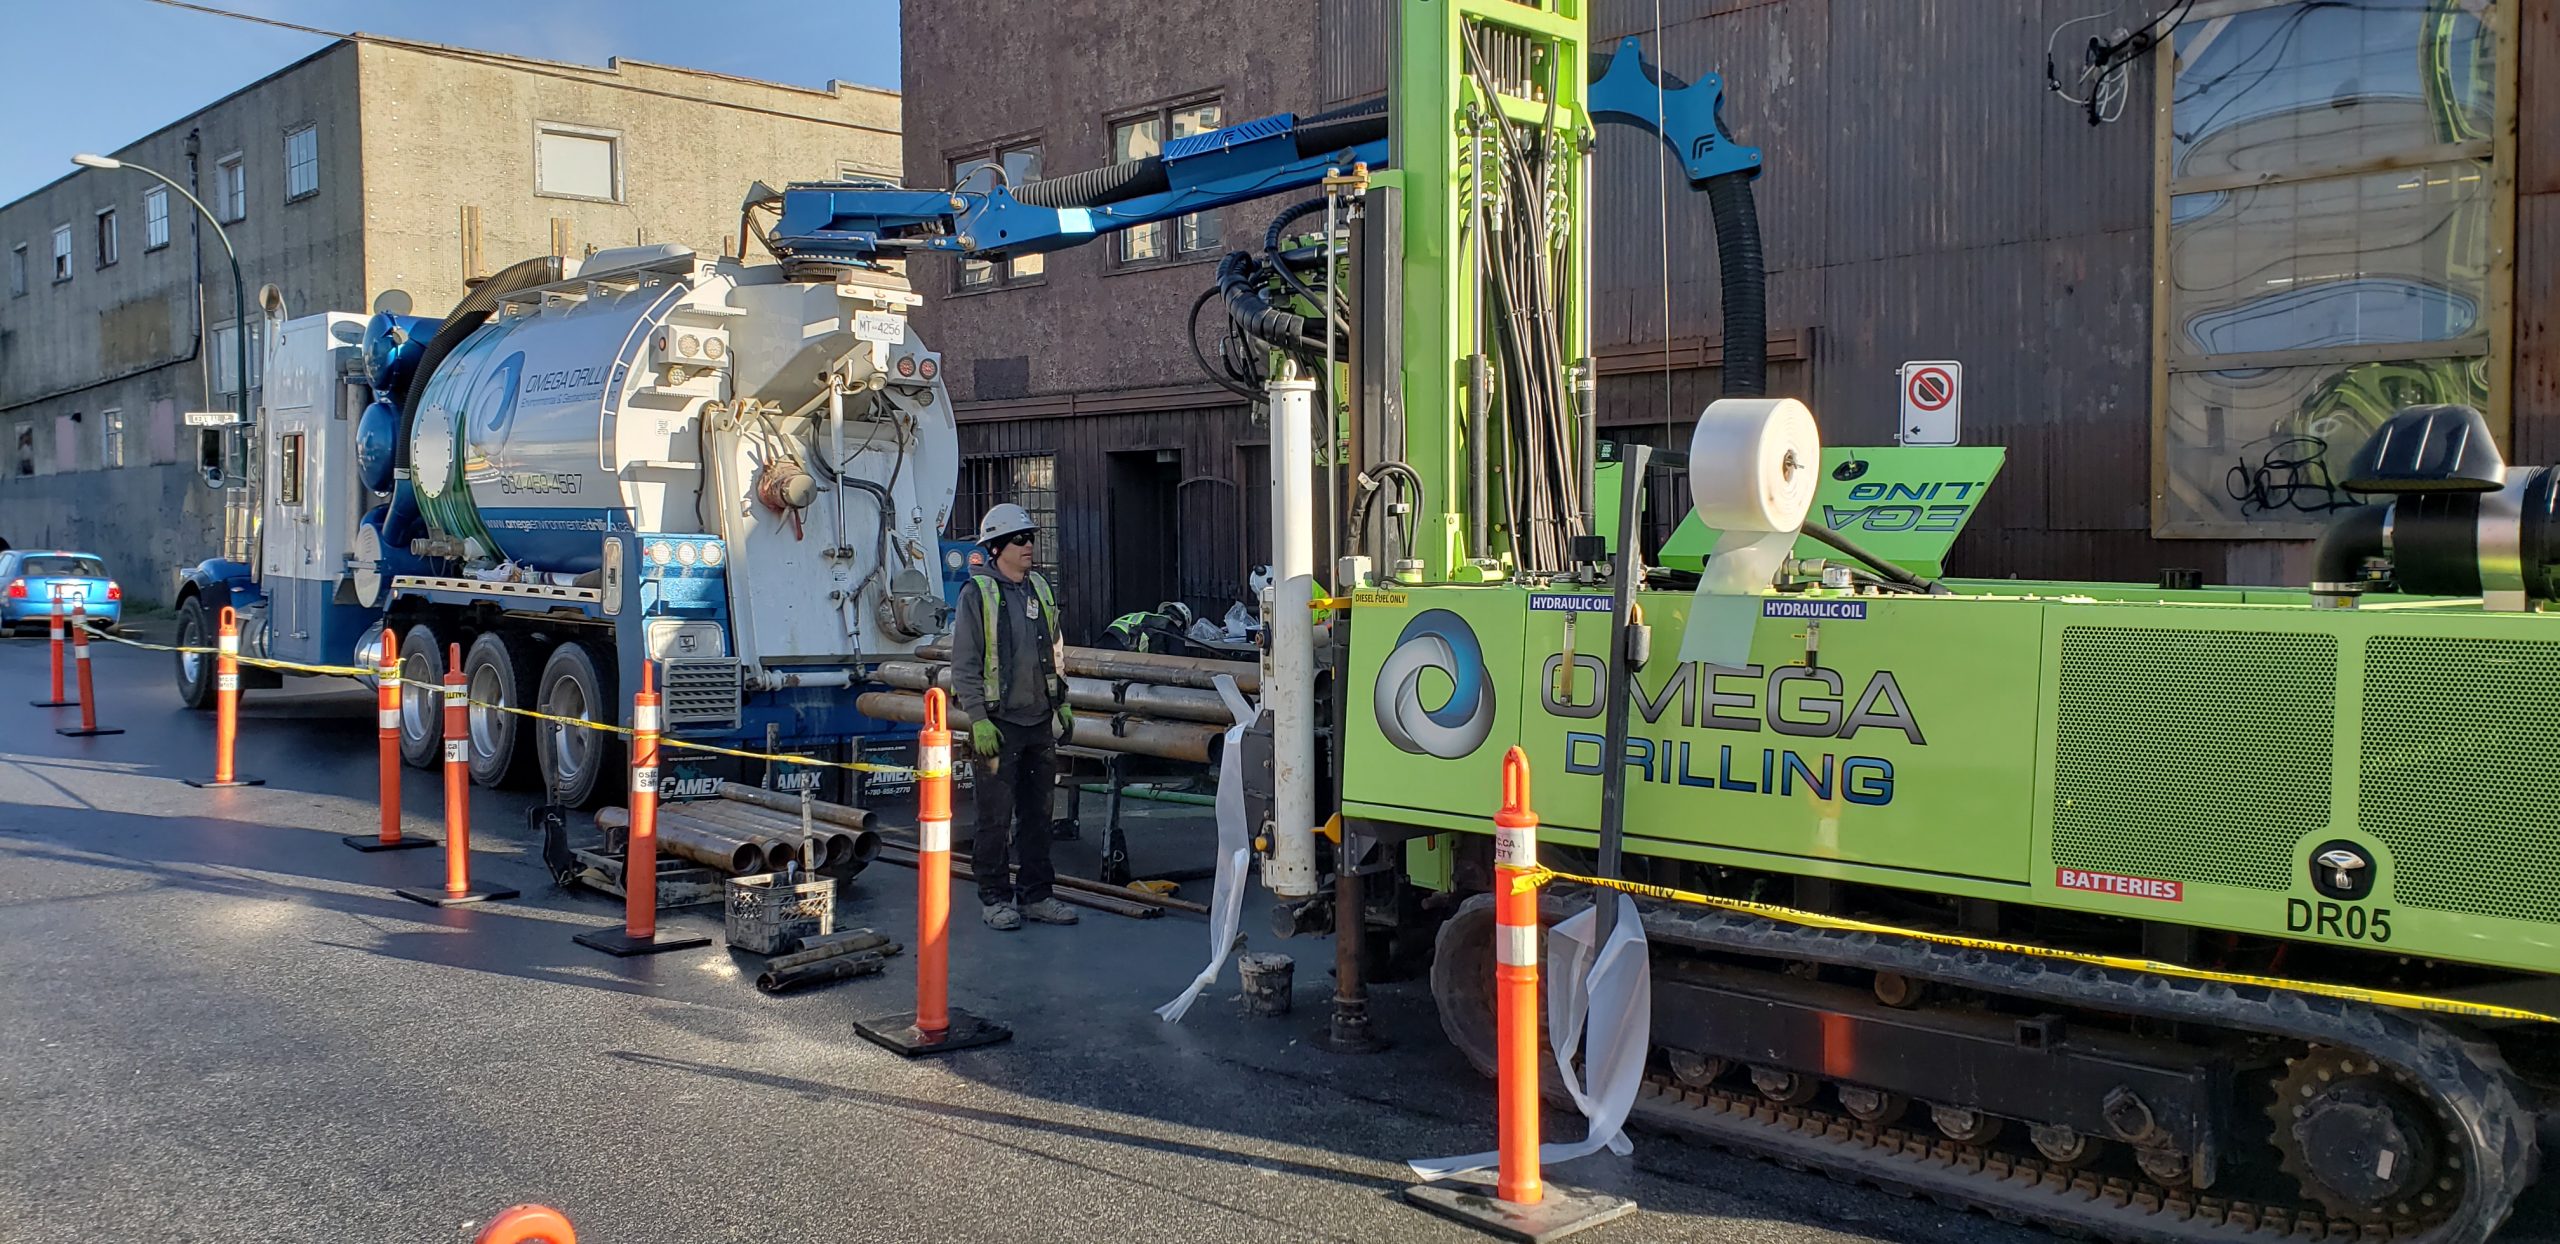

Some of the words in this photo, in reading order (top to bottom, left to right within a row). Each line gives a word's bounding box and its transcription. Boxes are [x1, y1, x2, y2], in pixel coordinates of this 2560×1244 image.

[526, 371, 567, 393] OMEGA
[1849, 481, 1986, 501] LING
[1355, 594, 1373, 603] DIESEL
[1375, 594, 1389, 603] FUEL
[1390, 594, 1406, 604] ONLY
[1532, 597, 1592, 610] HYDRAULIC
[1594, 599, 1612, 611] OIL
[1766, 602, 1839, 617] HYDRAULIC
[1841, 604, 1863, 618] OIL
[1541, 652, 1928, 746] OMEGA
[1565, 731, 1895, 806] DRILLING
[659, 776, 725, 799] CAMEX
[762, 771, 822, 789] AMX
[2061, 869, 2176, 899] BATTERIES
[2287, 897, 2392, 943] DR05
